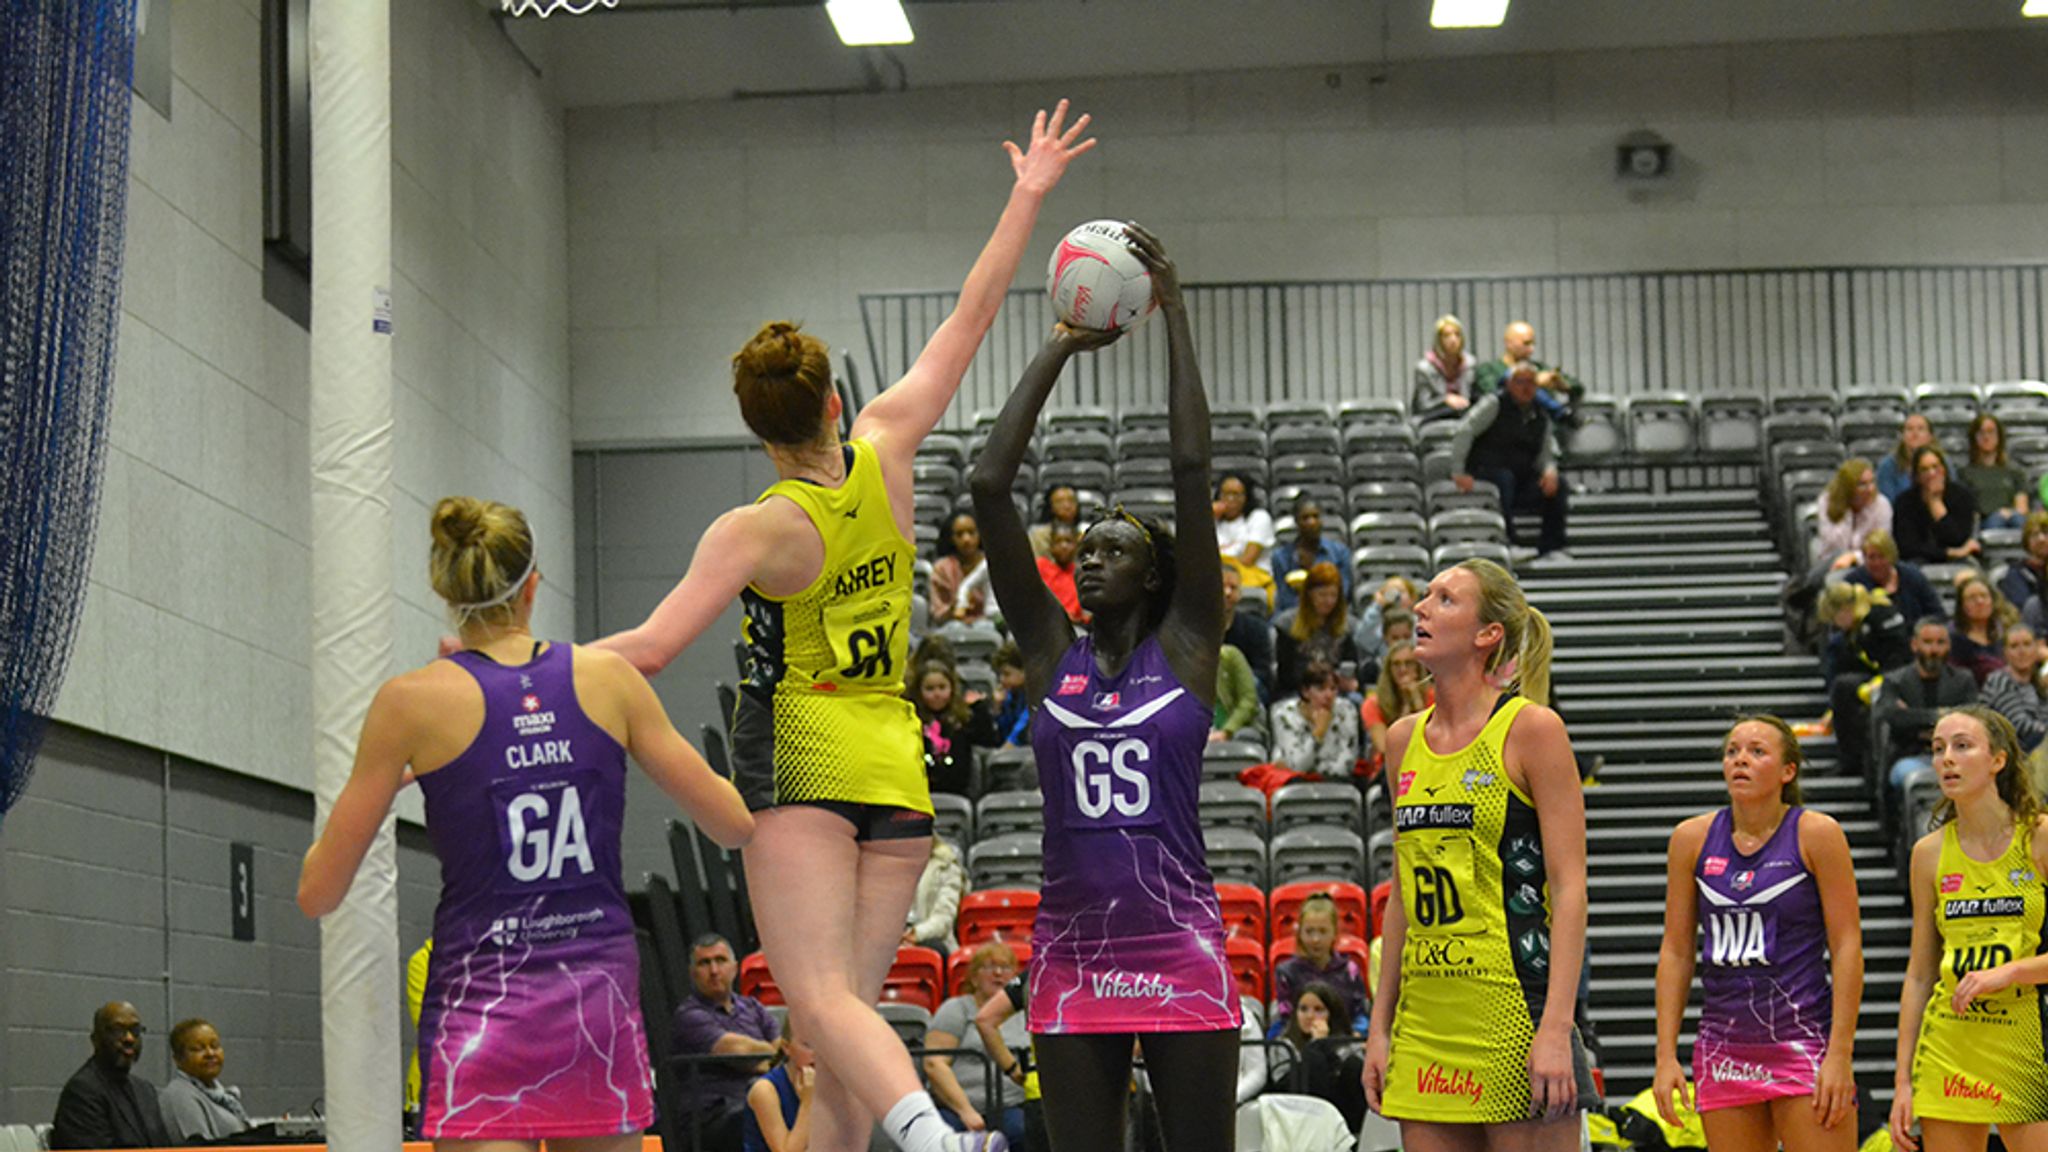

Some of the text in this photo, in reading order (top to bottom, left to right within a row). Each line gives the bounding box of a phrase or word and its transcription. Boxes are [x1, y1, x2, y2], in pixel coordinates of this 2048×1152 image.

[840, 620, 899, 679] GK
[512, 710, 556, 729] maxi
[505, 739, 574, 770] CLARK
[1072, 738, 1151, 819] GS
[507, 786, 595, 882] GA
[1428, 804, 1473, 824] fullex
[238, 861, 248, 919] 3
[1413, 866, 1465, 927] GD
[1982, 899, 2024, 914] fullex
[1415, 939, 1474, 967] C&C.
[1709, 911, 1771, 967] WA
[1092, 967, 1173, 1007] Vitality
[1417, 1060, 1484, 1106] Vitality
[1711, 1056, 1775, 1087] Vitality
[1943, 1072, 2003, 1109] Vitality
